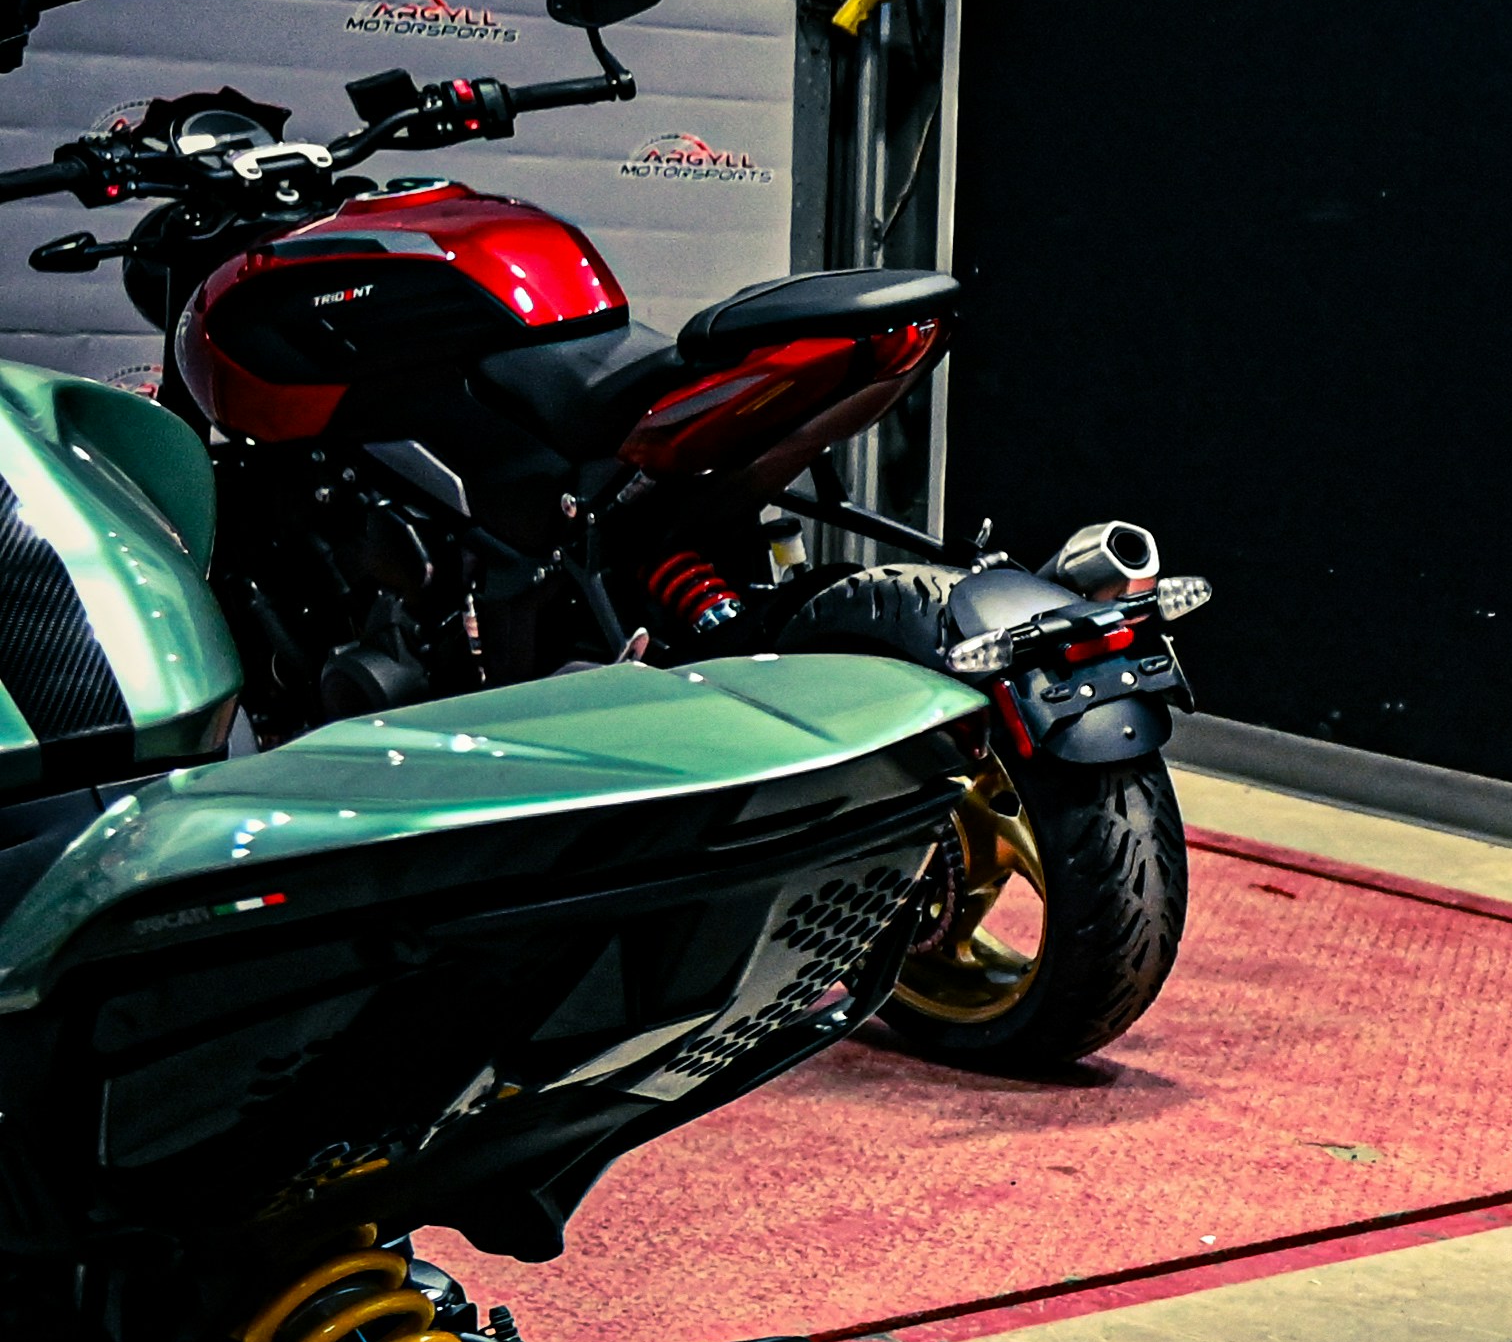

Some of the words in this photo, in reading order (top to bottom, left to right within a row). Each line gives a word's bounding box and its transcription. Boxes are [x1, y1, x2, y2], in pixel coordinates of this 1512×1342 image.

[373, 2, 498, 28] ARGYLL
[345, 15, 519, 43] MOTORSPORTS
[643, 149, 755, 170] ARGYLL
[619, 163, 773, 184] MOTORSPORTS
[314, 284, 374, 307] TRIDENT
